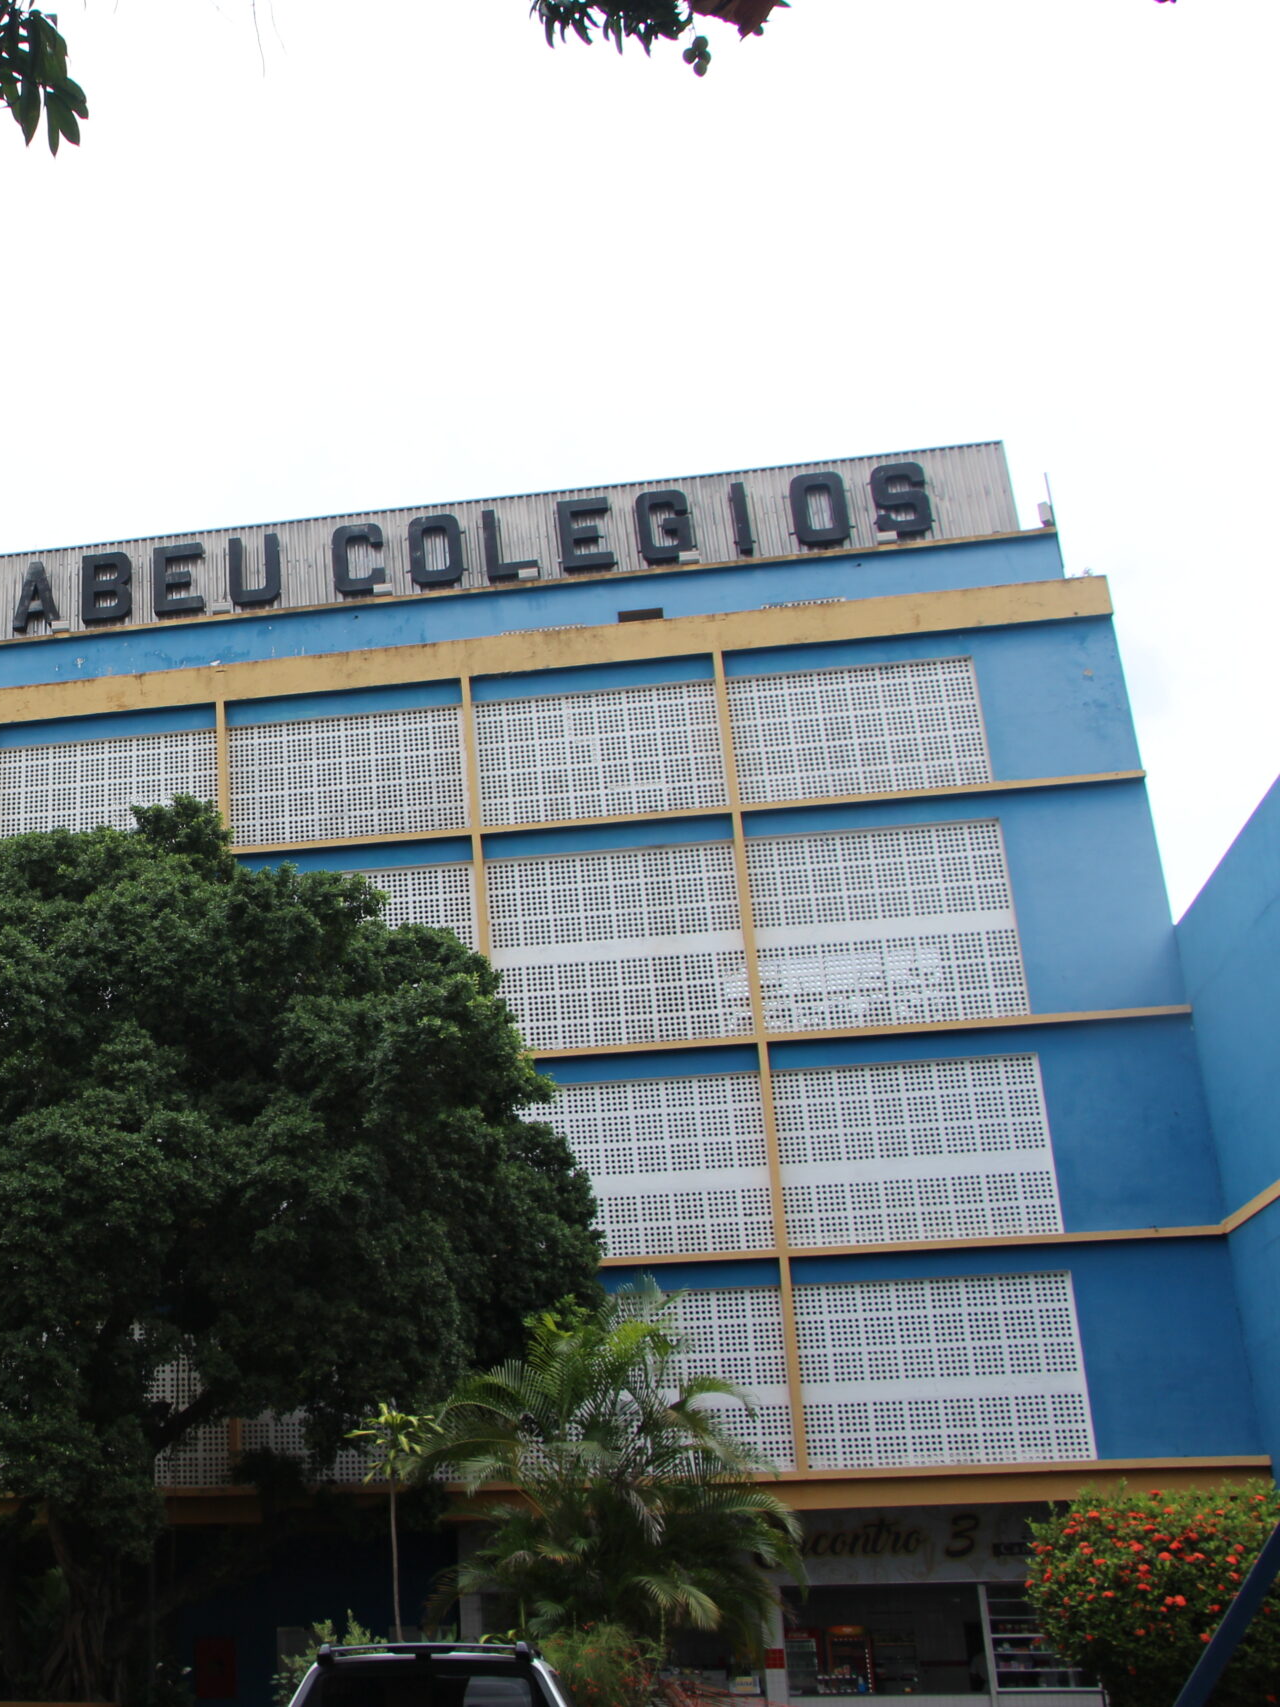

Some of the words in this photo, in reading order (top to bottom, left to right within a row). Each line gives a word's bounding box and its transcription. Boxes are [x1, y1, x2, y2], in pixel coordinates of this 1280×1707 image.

[12, 533, 282, 632] ABEU
[331, 461, 933, 595] COLEGIOS
[752, 1510, 924, 1566] contro
[945, 1513, 980, 1558] 3
